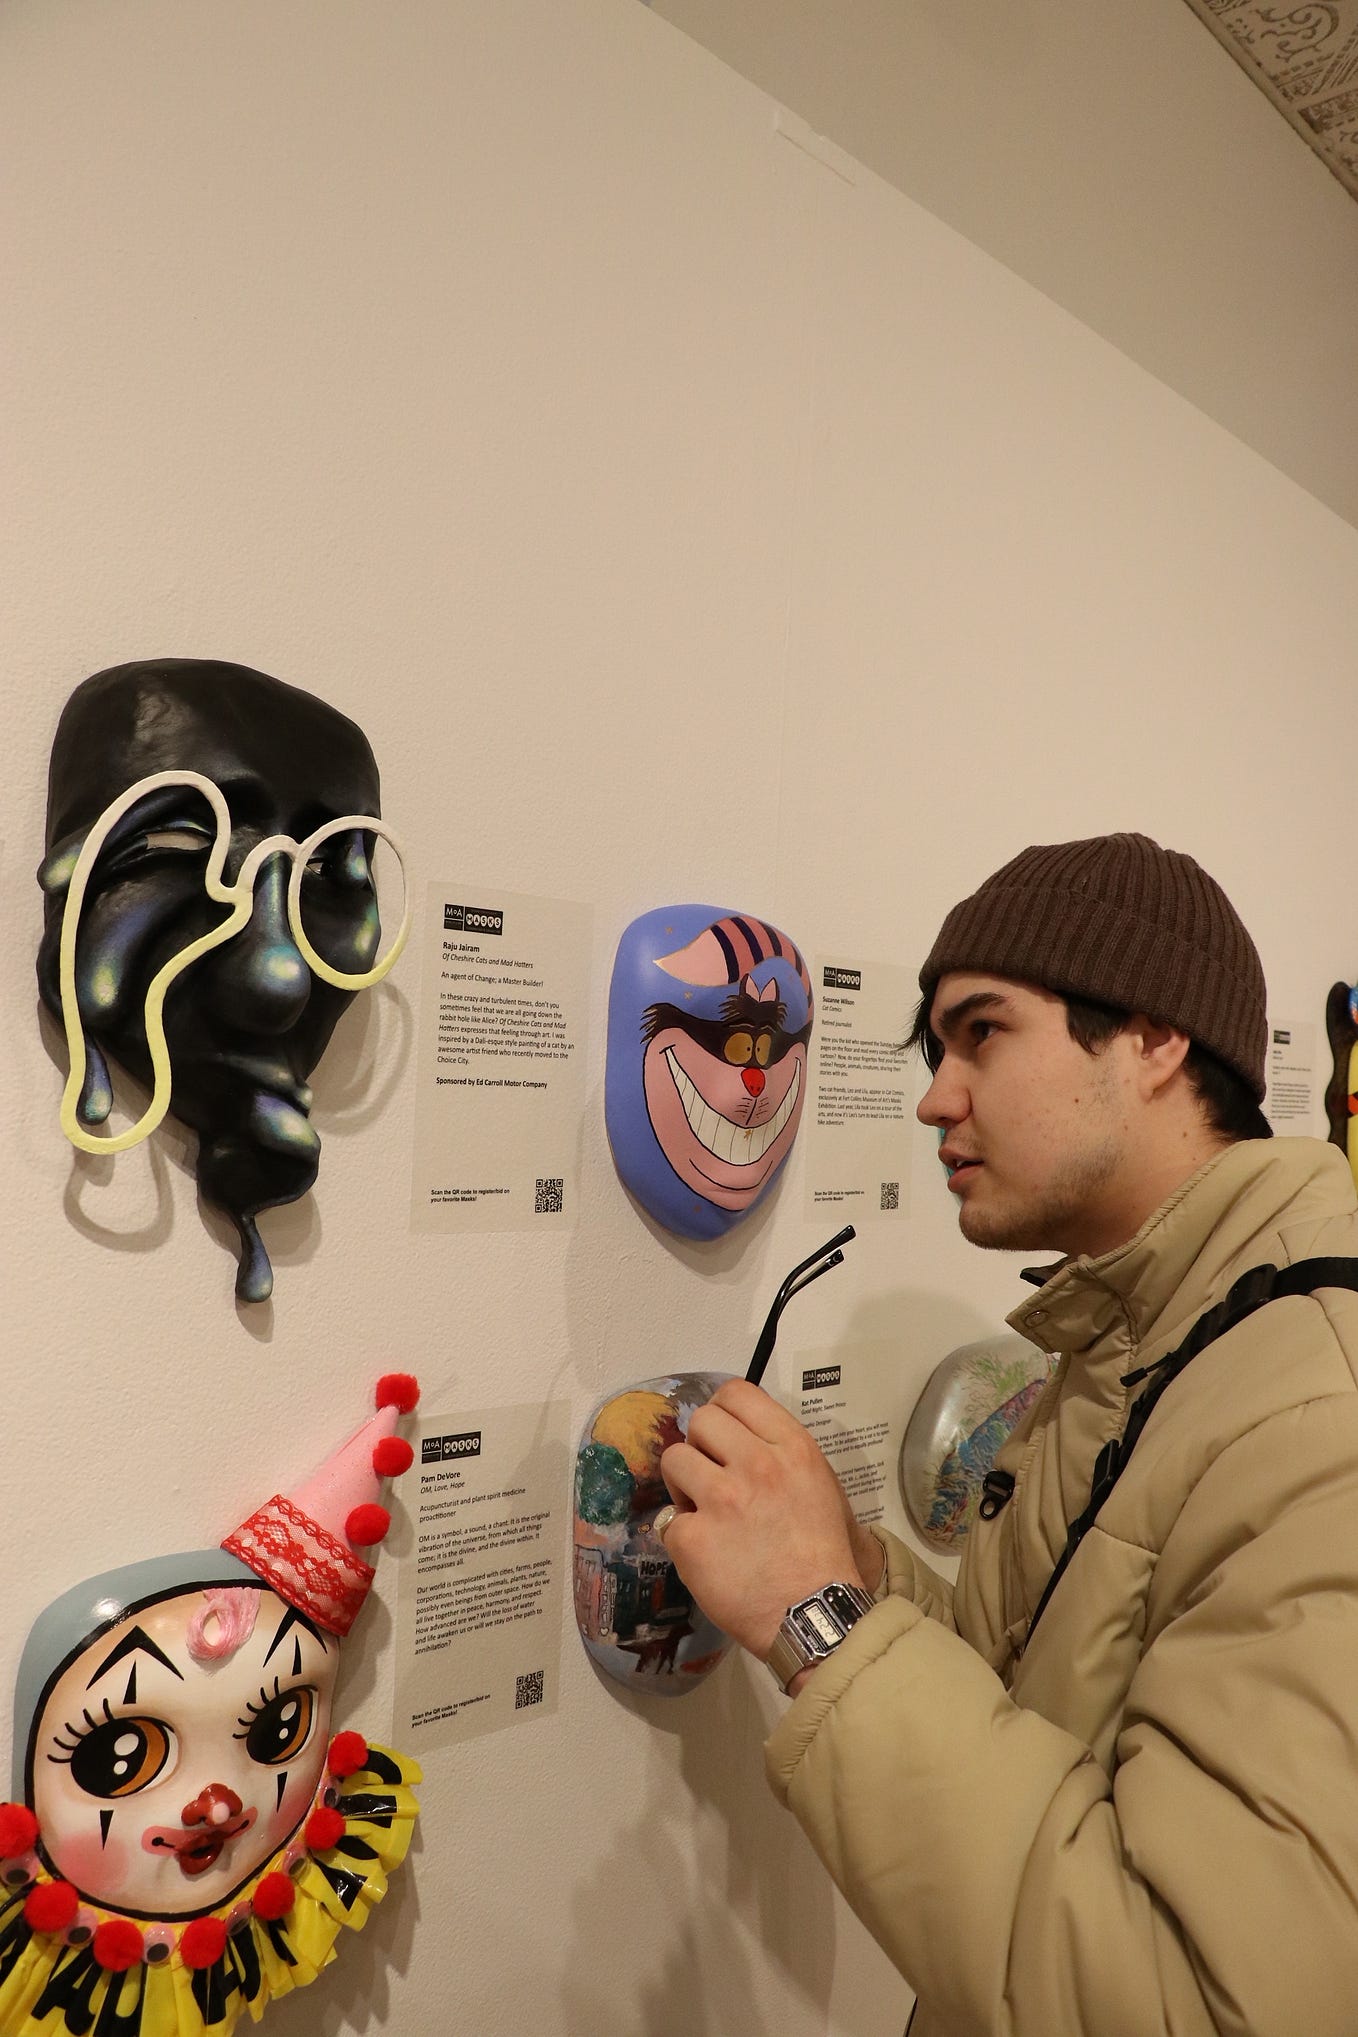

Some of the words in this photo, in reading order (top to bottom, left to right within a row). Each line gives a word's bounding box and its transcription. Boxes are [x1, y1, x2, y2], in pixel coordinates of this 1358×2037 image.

[466, 914, 501, 928] MASKS
[443, 942, 457, 951] Raju
[459, 944, 479, 952] Jairam
[450, 952, 474, 962] Cheshire
[501, 1028, 519, 1037] feeling
[462, 1036, 469, 1044] by
[444, 1438, 480, 1454] MASKS
[437, 1472, 460, 1480] DeVore
[420, 1500, 459, 1511] Acupuncturist
[472, 1495, 486, 1503] plant
[487, 1492, 500, 1500] spirit
[502, 1488, 525, 1497] medicine
[530, 1511, 550, 1520] original
[418, 1543, 443, 1552] vibration
[418, 1561, 455, 1573] encompasses
[429, 1582, 445, 1591] world
[452, 1573, 485, 1586] complicated
[416, 1592, 454, 1604] corporations,
